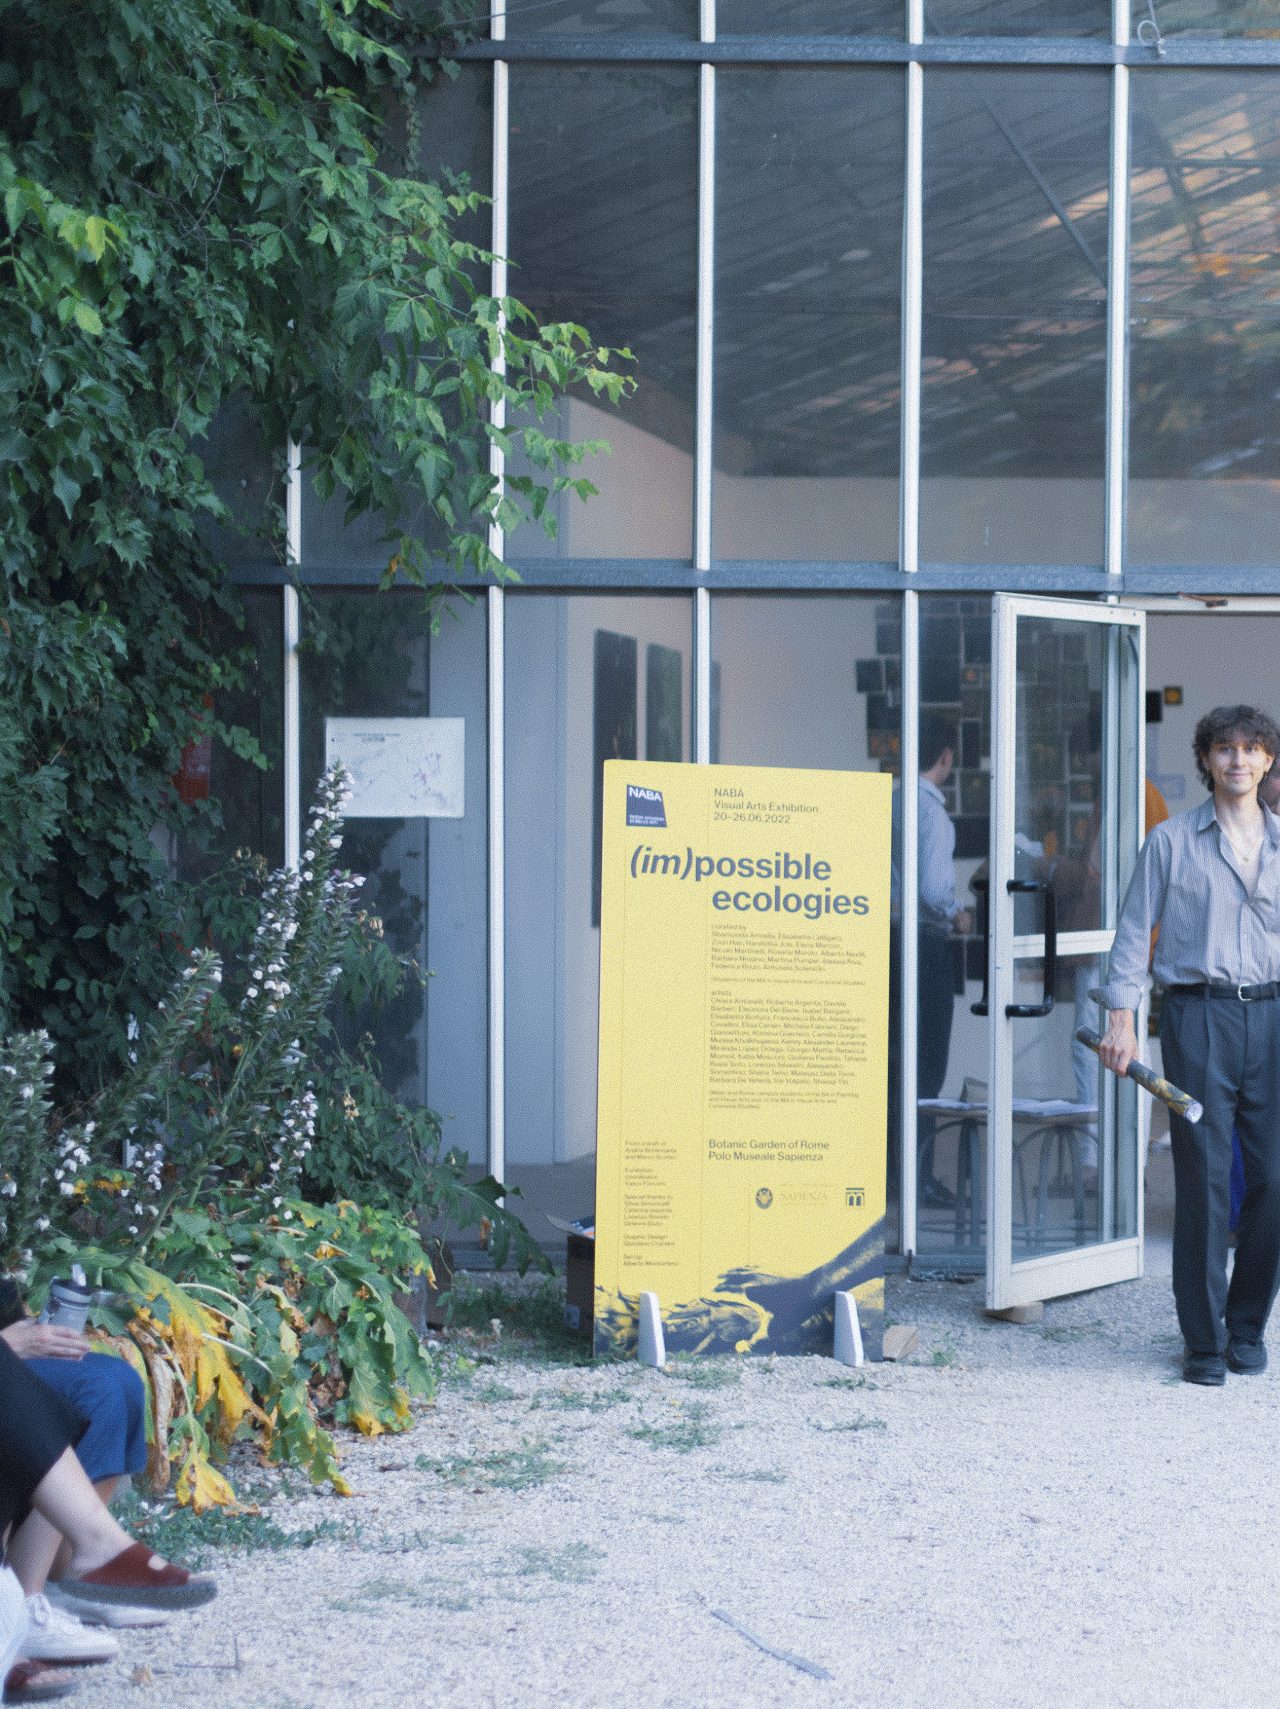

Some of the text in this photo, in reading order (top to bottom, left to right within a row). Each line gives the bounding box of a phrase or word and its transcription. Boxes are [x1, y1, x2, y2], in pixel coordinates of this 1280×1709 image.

[629, 786, 662, 801] NABA
[714, 788, 744, 798] NABA
[714, 800, 819, 813] Visual Arts Exhibition
[630, 844, 832, 882] (im)possible
[712, 885, 870, 920] ecologies
[708, 1139, 830, 1150] Botanic Garden of Rome
[708, 1151, 824, 1163] Polo Museale Sapienza
